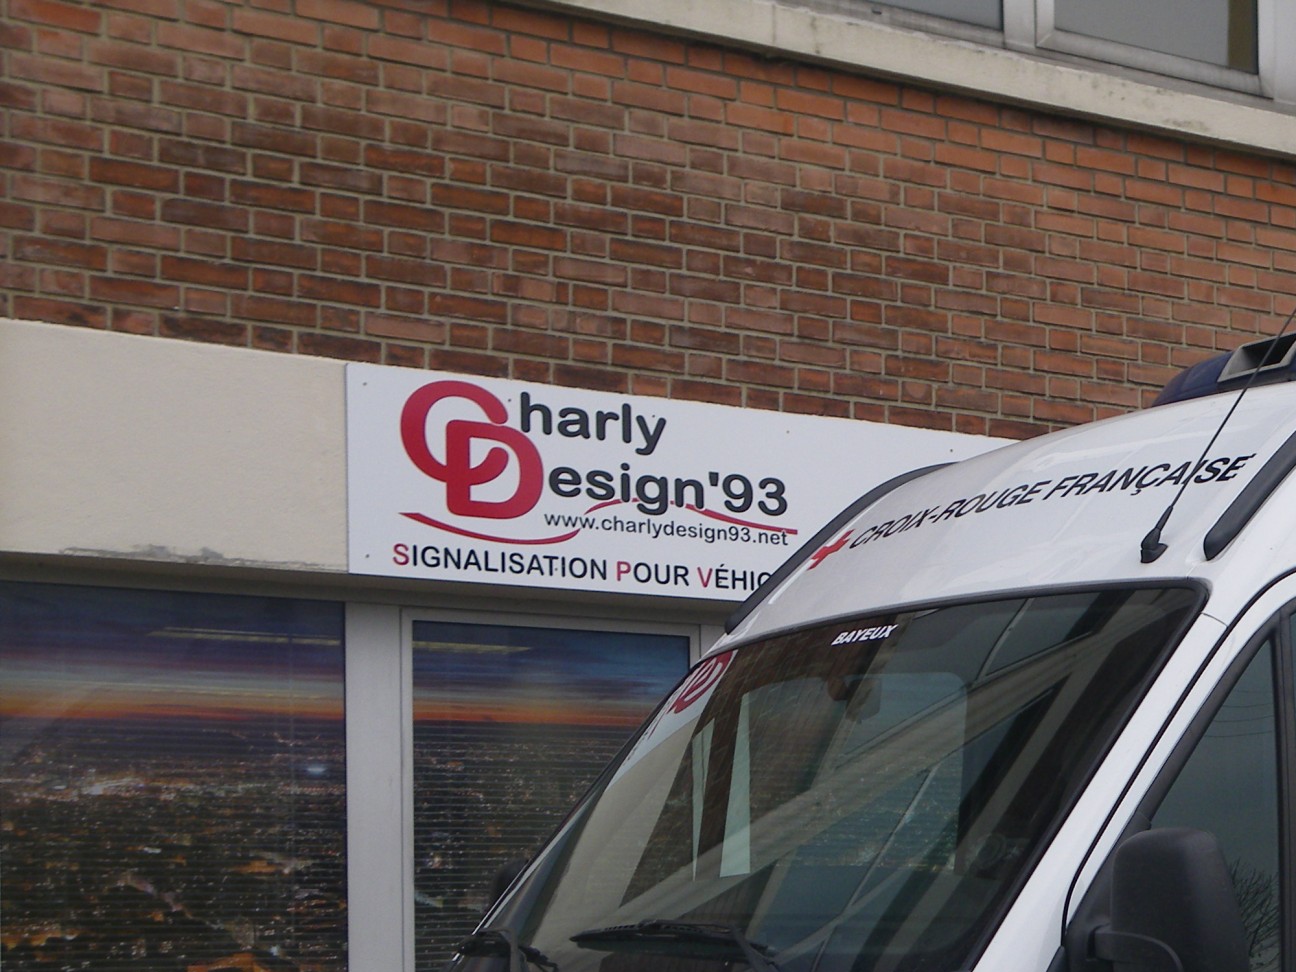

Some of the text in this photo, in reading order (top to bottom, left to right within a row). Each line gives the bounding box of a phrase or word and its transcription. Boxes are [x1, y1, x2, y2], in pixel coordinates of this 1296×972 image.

[849, 453, 1257, 549] CROIX-ROUGE FRANÇAISE
[544, 510, 789, 546] www.charlydesign93.net
[393, 543, 608, 581] SIGNALISATION
[616, 559, 690, 588] POUR
[831, 624, 899, 646] BAYEUX
